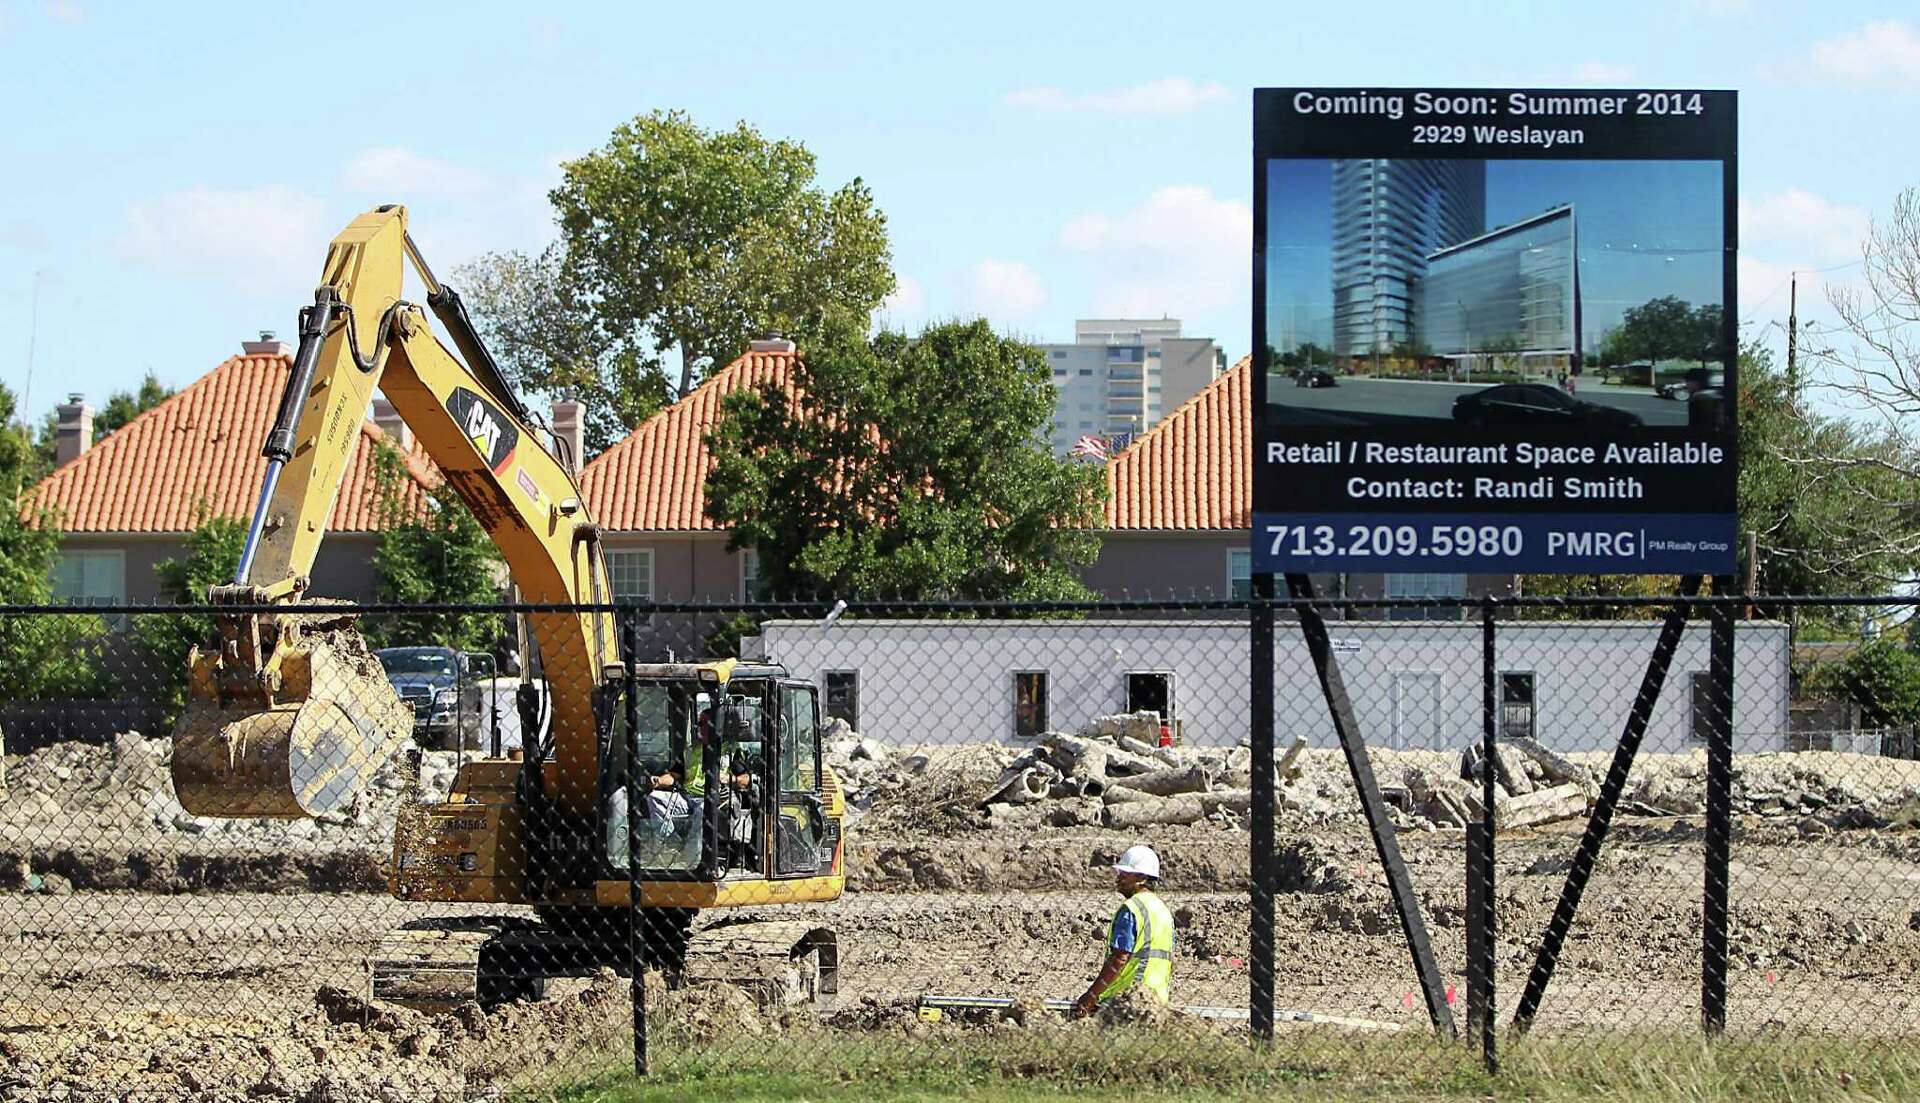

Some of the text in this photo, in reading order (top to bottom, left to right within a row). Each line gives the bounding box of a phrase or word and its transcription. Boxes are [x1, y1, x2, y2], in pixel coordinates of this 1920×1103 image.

[1293, 91, 1704, 120] Coming Soon: Summer 2014
[1413, 125, 1584, 149] 2929 Weslayan
[469, 400, 502, 463] CAT
[1267, 441, 1723, 469] Retail / Restaurant Space Available
[1347, 476, 1643, 498] Contact: Randi Smith
[1266, 525, 1635, 557] 713.209.5980 PMRG
[1649, 540, 1729, 552] PM Realty Group
